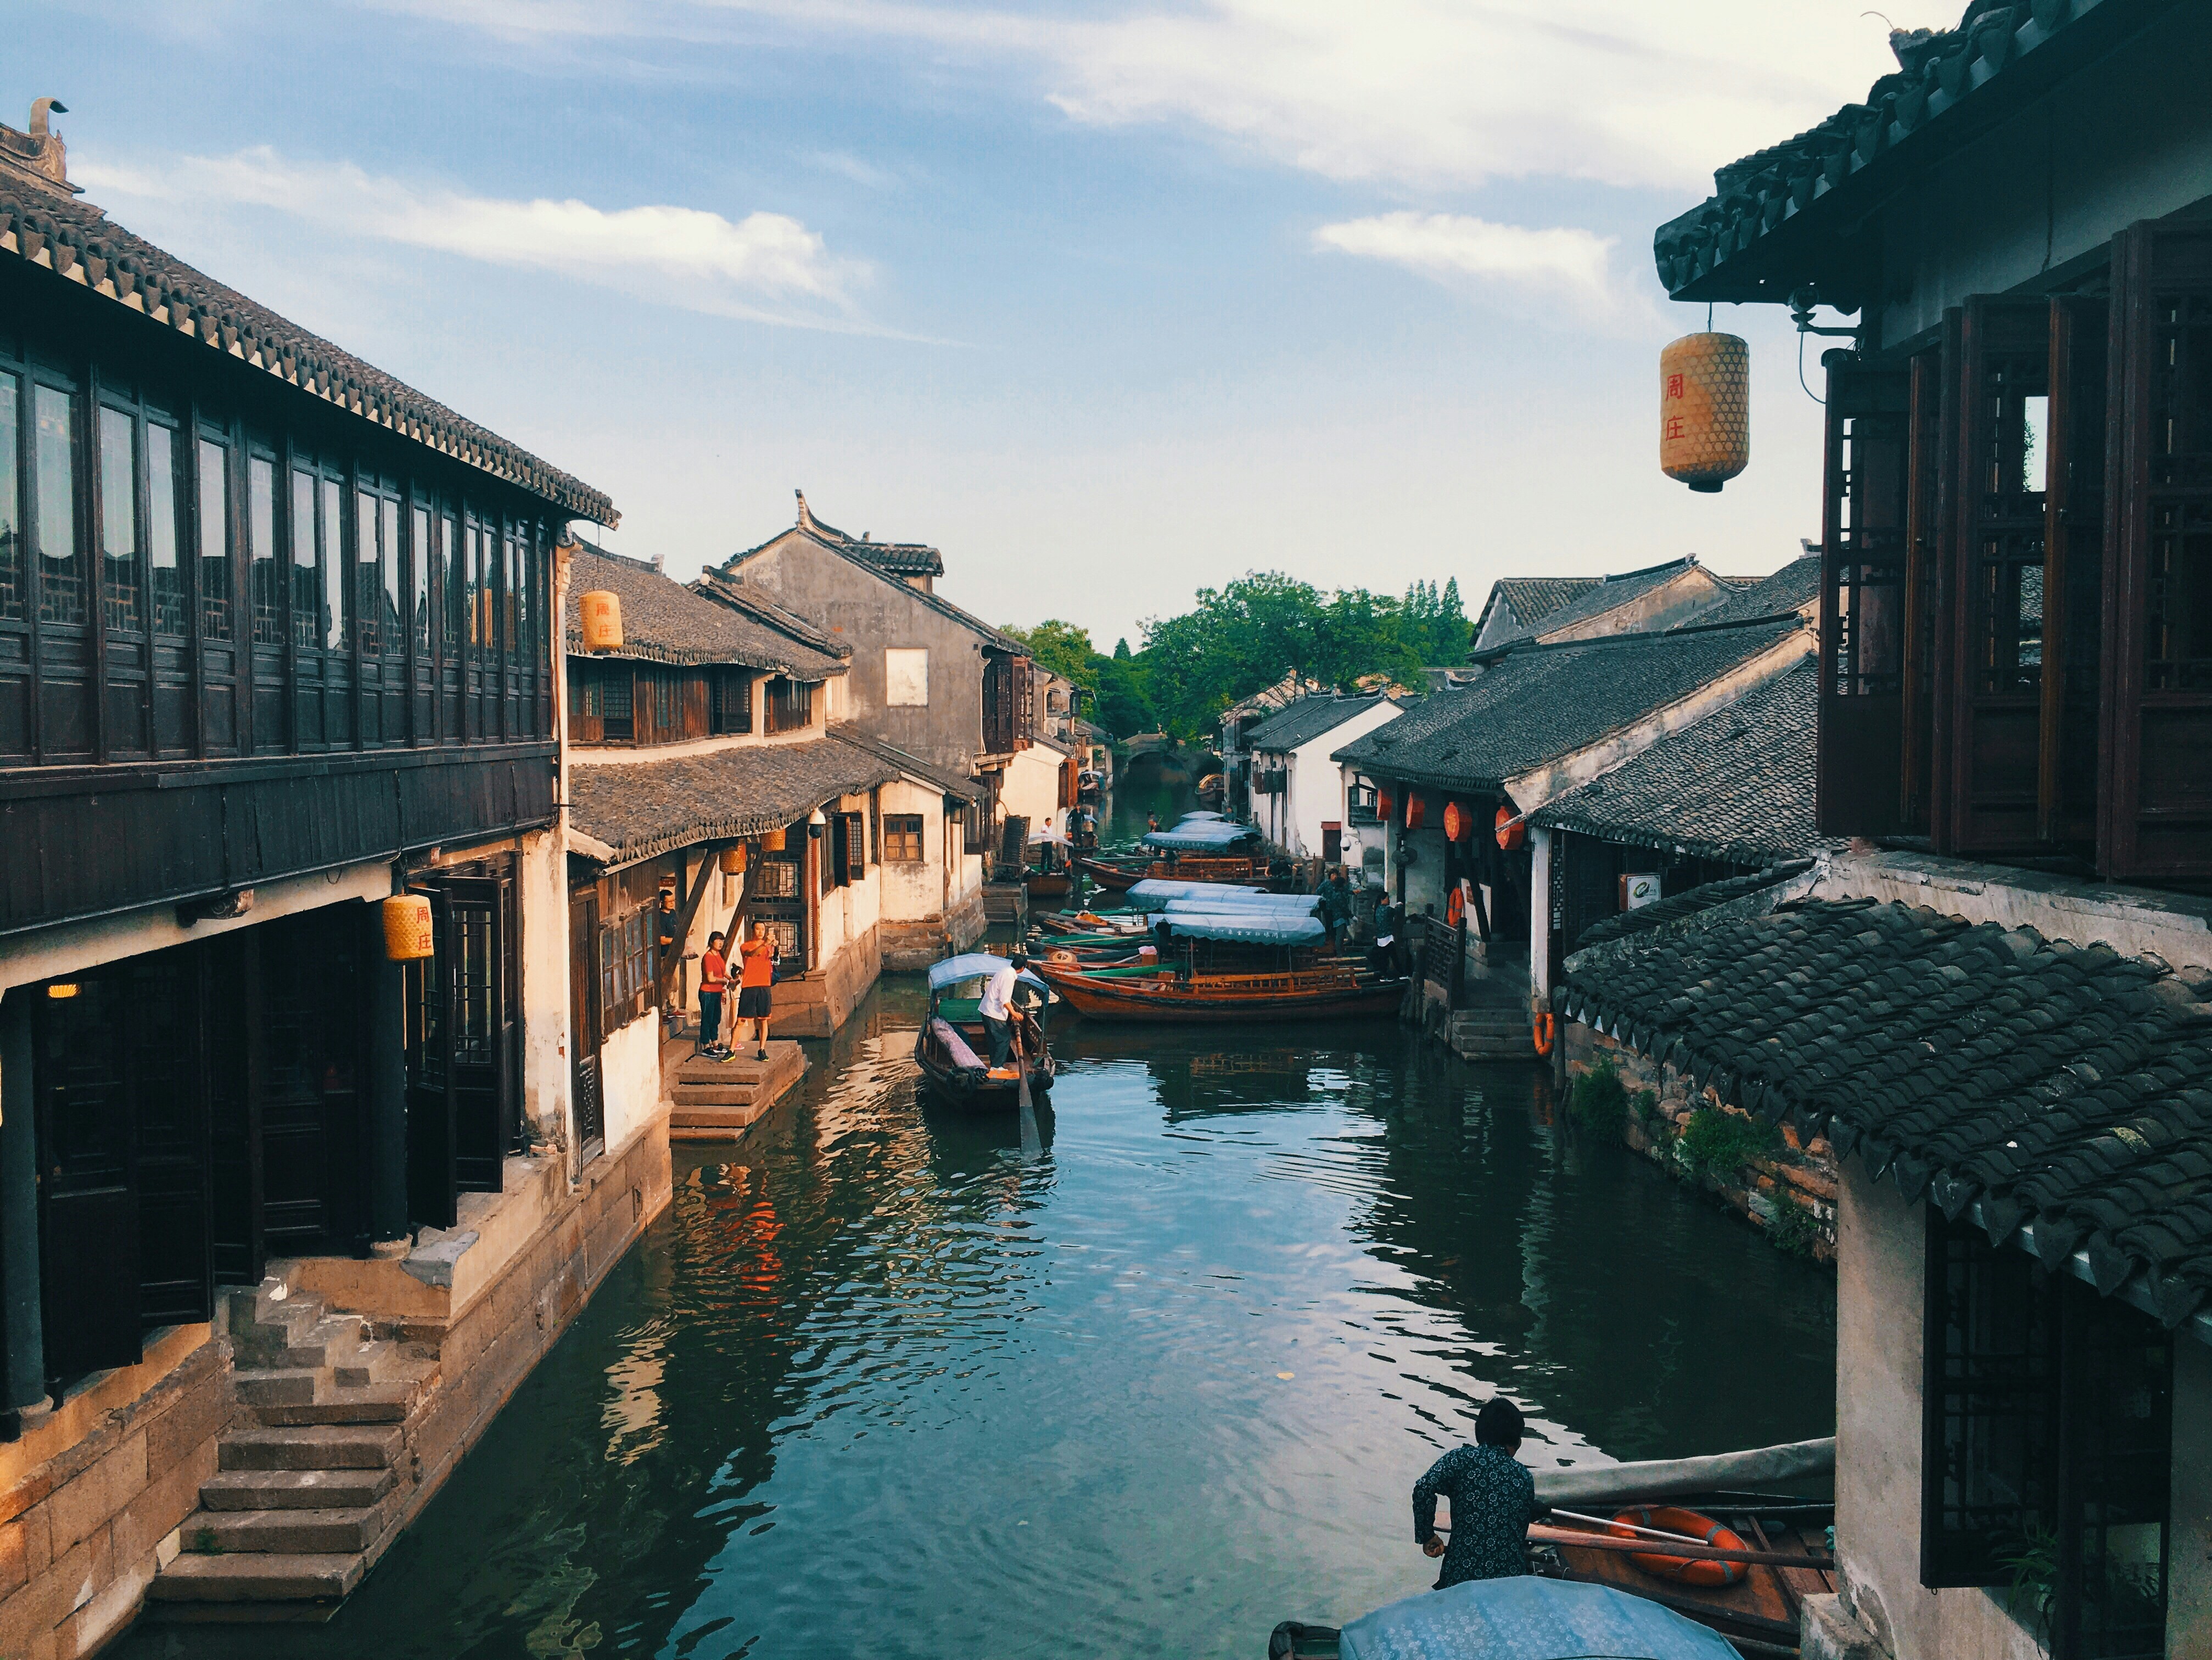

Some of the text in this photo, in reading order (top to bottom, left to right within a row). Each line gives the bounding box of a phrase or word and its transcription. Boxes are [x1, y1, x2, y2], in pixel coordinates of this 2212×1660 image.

[1665, 373, 1685, 442] 周庄
[596, 602, 613, 637] 周庄
[416, 906, 432, 951] 周庄
